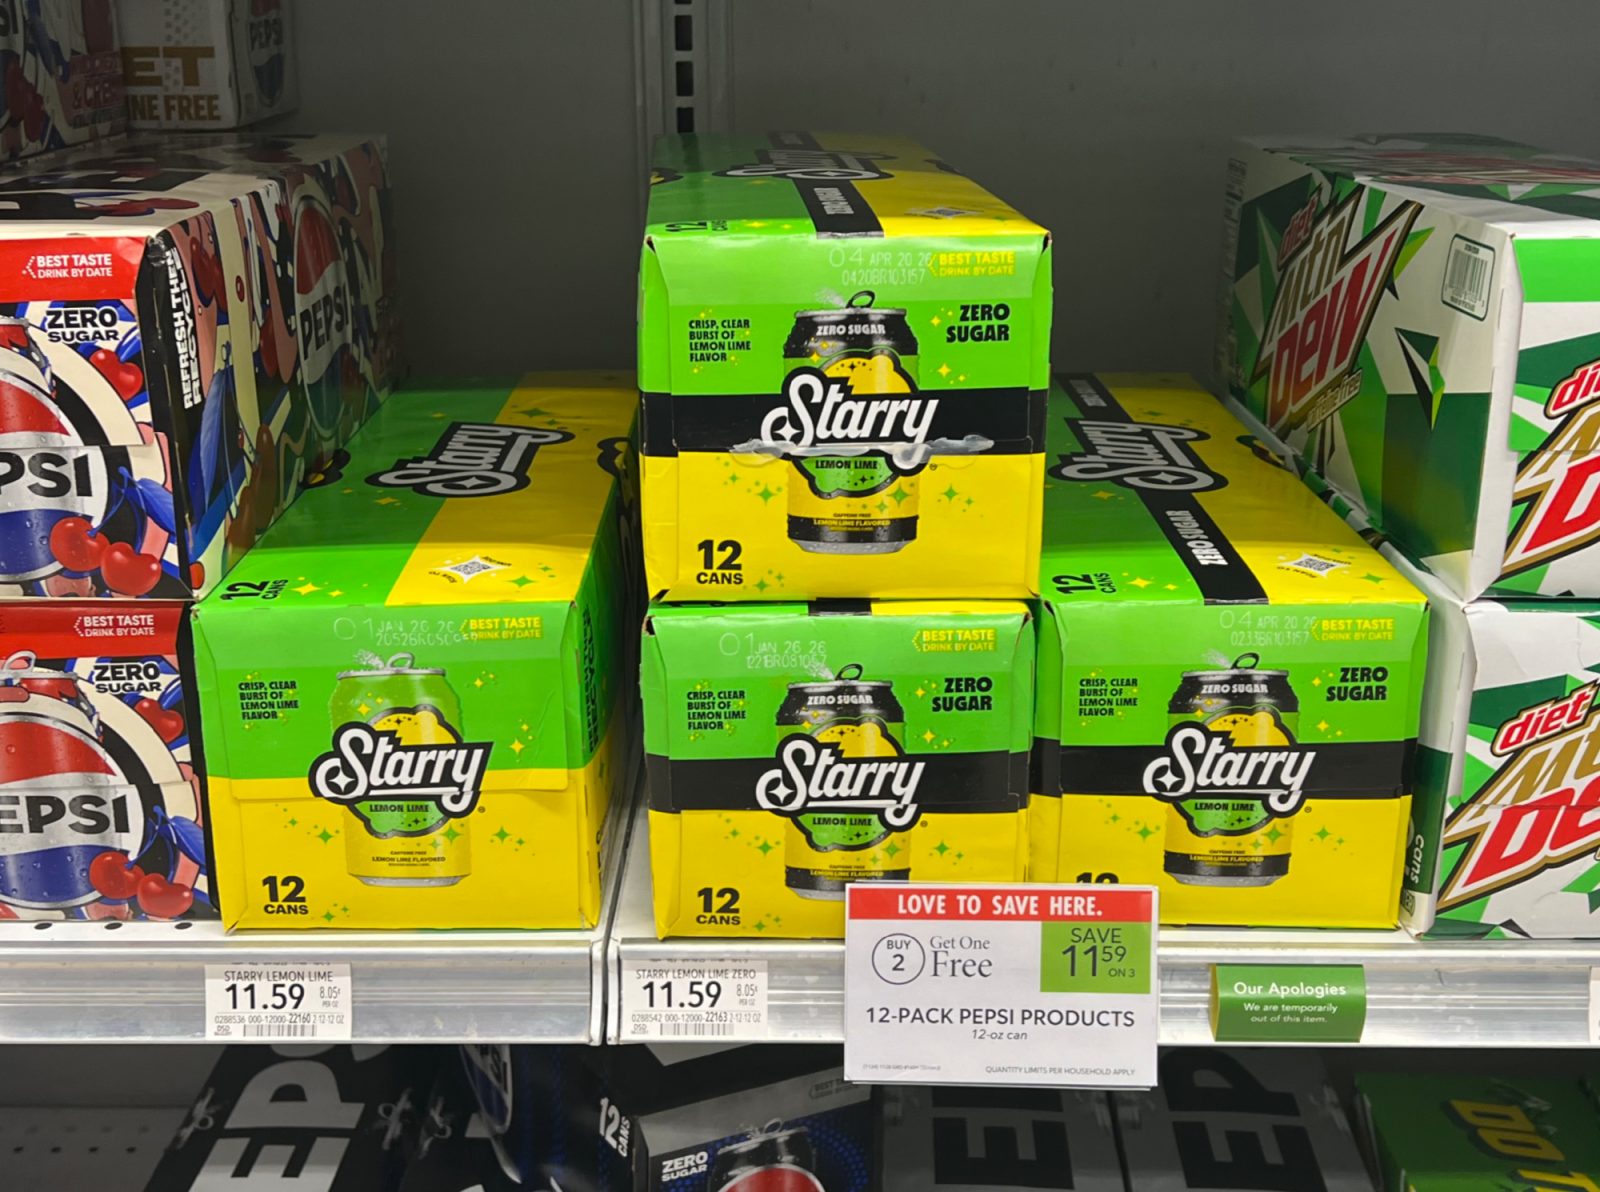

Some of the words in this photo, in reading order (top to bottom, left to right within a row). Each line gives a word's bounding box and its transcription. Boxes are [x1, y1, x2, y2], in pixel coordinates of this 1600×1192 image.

[163, 95, 221, 120] FREE
[37, 255, 70, 267] BEST
[72, 253, 112, 267] TASTE
[939, 253, 971, 265] BEST
[975, 251, 1015, 264] TASTE
[38, 268, 70, 279] DRINK
[71, 268, 85, 278] BY
[85, 267, 113, 278] DATE
[939, 267, 970, 277] DRINK
[973, 266, 987, 276] BY
[988, 265, 1015, 275] DATE
[165, 250, 182, 309] THEN
[45, 308, 118, 329] ZERO
[300, 280, 351, 360] PEPSI
[959, 303, 1010, 321] ZERO
[171, 247, 202, 405] RECYCLE
[688, 319, 719, 330] CRISP,
[721, 319, 750, 329] CLEAR
[816, 324, 846, 336] ZERO
[847, 324, 886, 335] SUGAR
[48, 329, 119, 343] SUGAR
[689, 330, 719, 340] BURST
[721, 330, 736, 340] OF
[946, 324, 1010, 343] SUGAR
[689, 341, 725, 351] LEMON
[727, 341, 751, 351] LIME
[173, 310, 194, 409] REFRESH
[689, 352, 727, 362] FLAVOR
[760, 373, 939, 471] Starry
[378, 424, 563, 496] Starry
[1061, 420, 1214, 490] Starry
[815, 460, 852, 470] LEMON
[854, 459, 879, 470] LIME
[1165, 510, 1209, 539] SUGAR
[697, 540, 743, 570] 12
[1187, 540, 1229, 566] ZERO
[696, 572, 744, 585] CANS
[1056, 573, 1097, 595] 12
[1097, 572, 1117, 594] CANS
[219, 580, 270, 600] 12
[83, 615, 114, 627] BEST
[117, 614, 154, 626] TASTE
[469, 618, 501, 630] BEST
[503, 617, 541, 629] TASTE
[1321, 620, 1353, 631] BEST
[1356, 618, 1394, 630] TASTE
[85, 628, 112, 637] DRINK
[113, 627, 128, 636] BY
[129, 626, 155, 636] DATE
[921, 631, 953, 642] BEST
[956, 629, 995, 641] TASTE
[922, 643, 953, 652] DRINK
[954, 642, 968, 652] BY
[969, 641, 994, 651] DATE
[94, 663, 161, 681] ZERO
[1339, 666, 1388, 683] ZERO
[96, 681, 162, 694] SUGAR
[944, 676, 993, 694] ZERO
[1201, 684, 1230, 694] ZERO
[1231, 683, 1269, 693] SUGAR
[1326, 685, 1387, 701] SUGAR
[687, 691, 716, 701] CRISP,
[717, 690, 746, 700] CLEAR
[807, 695, 835, 705] ZERO
[836, 694, 873, 704] SUGAR
[931, 695, 992, 712] SUGAR
[687, 701, 716, 711] BURST
[717, 701, 731, 710] OF
[687, 711, 723, 721] LEMON
[723, 710, 746, 720] LIME
[1499, 690, 1592, 750] diet
[687, 721, 724, 731] FLAVOR
[315, 728, 485, 812] Starry
[1142, 727, 1316, 812] Starry
[756, 739, 926, 826] Starry
[0, 794, 130, 834] EPSI
[369, 804, 405, 813] LEMON
[406, 804, 430, 813] LIME
[1194, 802, 1230, 811] LEMON
[1231, 802, 1255, 811] LIME
[812, 816, 847, 826] LEMON
[849, 816, 872, 826] LIME
[1410, 833, 1425, 885] cans
[262, 876, 306, 902] 12
[697, 887, 740, 913] 12
[898, 894, 946, 915] LOVE
[956, 895, 981, 914] TO
[992, 895, 1039, 916] SAVE
[1050, 896, 1103, 917] HERE.
[264, 903, 309, 916] CANS
[696, 914, 741, 925] CANS
[930, 936, 956, 950] Get
[960, 936, 990, 950] One
[1070, 928, 1122, 944] SAVE
[886, 940, 911, 950] BUY
[892, 954, 905, 971] 2
[932, 951, 993, 978] Free
[224, 970, 263, 982] STARRY
[266, 970, 305, 982] LEMON
[308, 970, 333, 982] LIME
[636, 969, 669, 980] STARRY
[672, 969, 705, 980] LEMON
[708, 969, 729, 980] LIME
[731, 969, 756, 980] ZERO
[1108, 969, 1127, 978] ON
[1128, 969, 1136, 977] 3
[225, 983, 305, 1010] 11.59
[642, 981, 722, 1008] 11.59
[1233, 982, 1263, 995] Our
[1268, 982, 1347, 999] Apologies
[1243, 1002, 1261, 1012] We
[1263, 1003, 1279, 1012] are
[1281, 1002, 1338, 1014] temporarily
[866, 1007, 953, 1024] 12-PACK
[959, 1008, 1014, 1025] PEPSI
[1021, 1010, 1135, 1027] PRODUCTS
[1250, 1015, 1268, 1023] out
[1270, 1015, 1281, 1023] of
[1283, 1015, 1301, 1023] this
[1303, 1015, 1328, 1023] item.
[972, 1029, 1004, 1040] 12-oz
[1006, 1031, 1028, 1040] can
[985, 1066, 1022, 1074] QUANTITY
[1024, 1066, 1048, 1074] LIMITS
[1049, 1066, 1063, 1074] PER
[1064, 1067, 1112, 1075] HOUSEHOLD
[1112, 1068, 1136, 1076] APPLY
[599, 1097, 620, 1150] 12
[617, 1116, 631, 1158] CANS
[662, 1151, 709, 1174] ZERO
[661, 1164, 708, 1182] SUGAR
